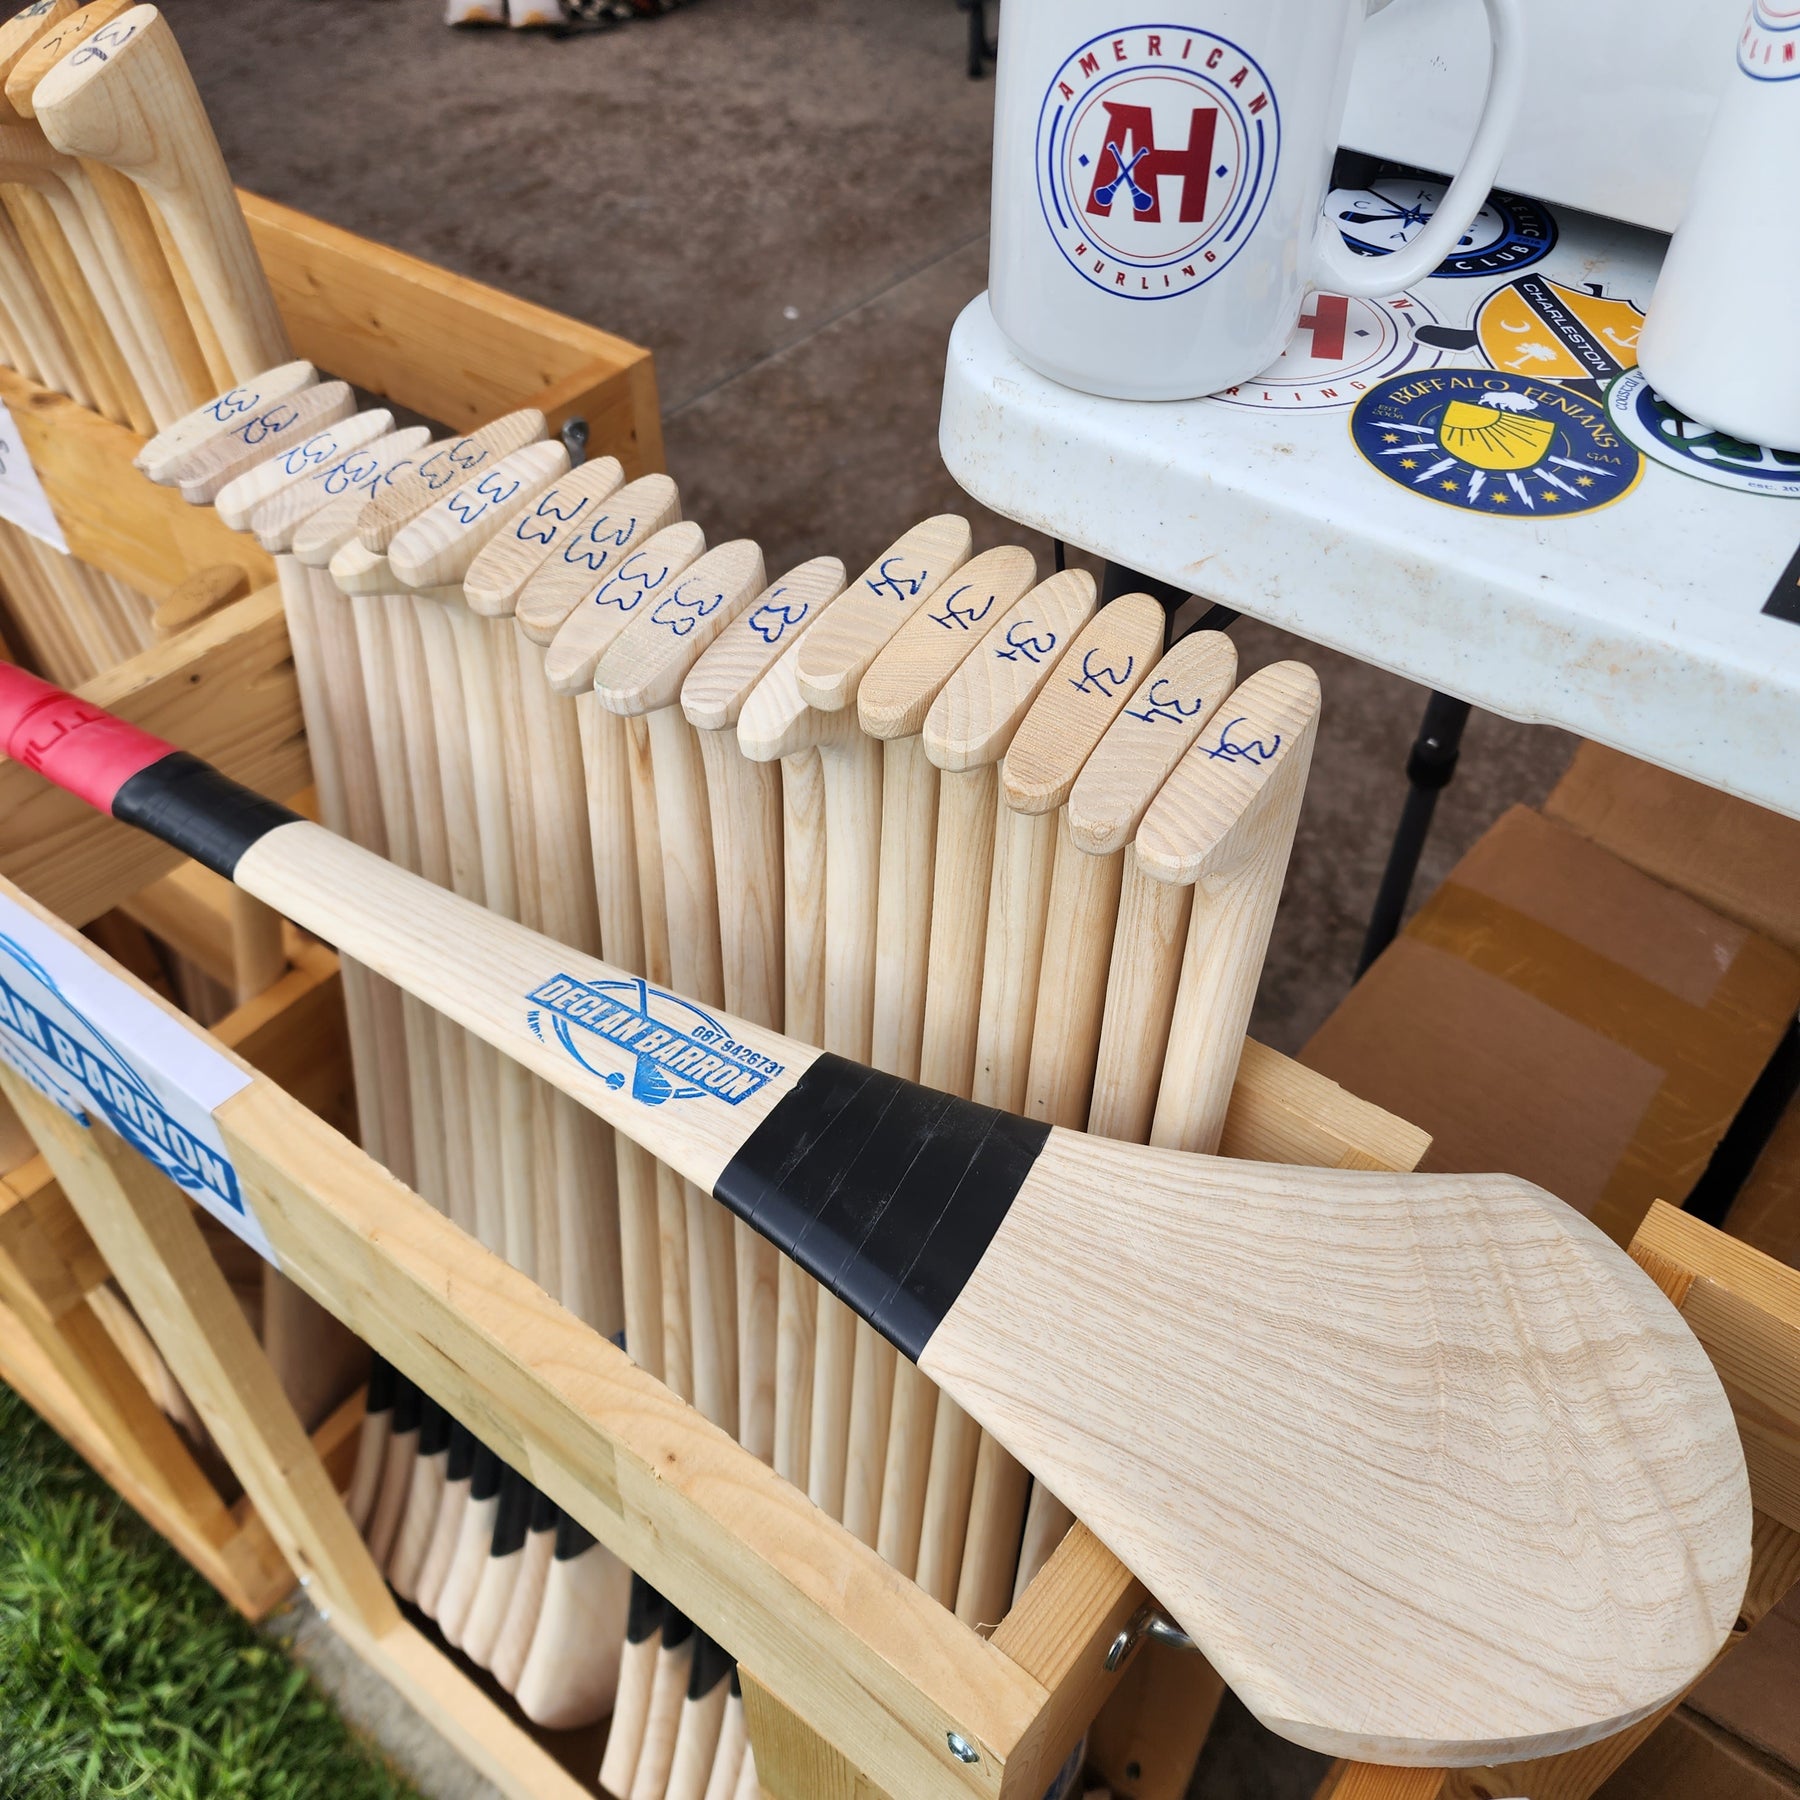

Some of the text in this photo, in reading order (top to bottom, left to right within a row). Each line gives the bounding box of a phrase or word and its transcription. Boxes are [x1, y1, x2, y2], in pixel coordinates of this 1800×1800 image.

[1058, 35, 1269, 116] AMERICAN
[1085, 100, 1219, 224] AH
[1075, 242, 1217, 290] HURLING
[1455, 244, 1530, 271] CLUB
[1522, 283, 1612, 372] CHARLESTON
[203, 389, 261, 422] 32
[230, 405, 299, 444] 32
[1389, 376, 1620, 449] BUFFALO FENIANS
[275, 433, 337, 474] 32
[313, 451, 378, 494] 32
[420, 438, 488, 489] 33
[1586, 452, 1623, 465] GAA
[449, 472, 521, 524] 33
[516, 490, 589, 544] 33
[564, 516, 636, 570] 33
[595, 552, 669, 611] 33
[865, 557, 928, 601] 34
[650, 577, 723, 636] 33
[749, 587, 809, 643] 33
[927, 584, 995, 630] 34
[995, 620, 1056, 663] 34
[1068, 647, 1134, 697] 34
[1125, 679, 1202, 724] 34
[1197, 717, 1281, 766] 34
[534, 979, 763, 1100] DECLAN BARRON
[691, 1025, 786, 1078] 087 9426731
[56, 1033, 232, 1202] BARRON
